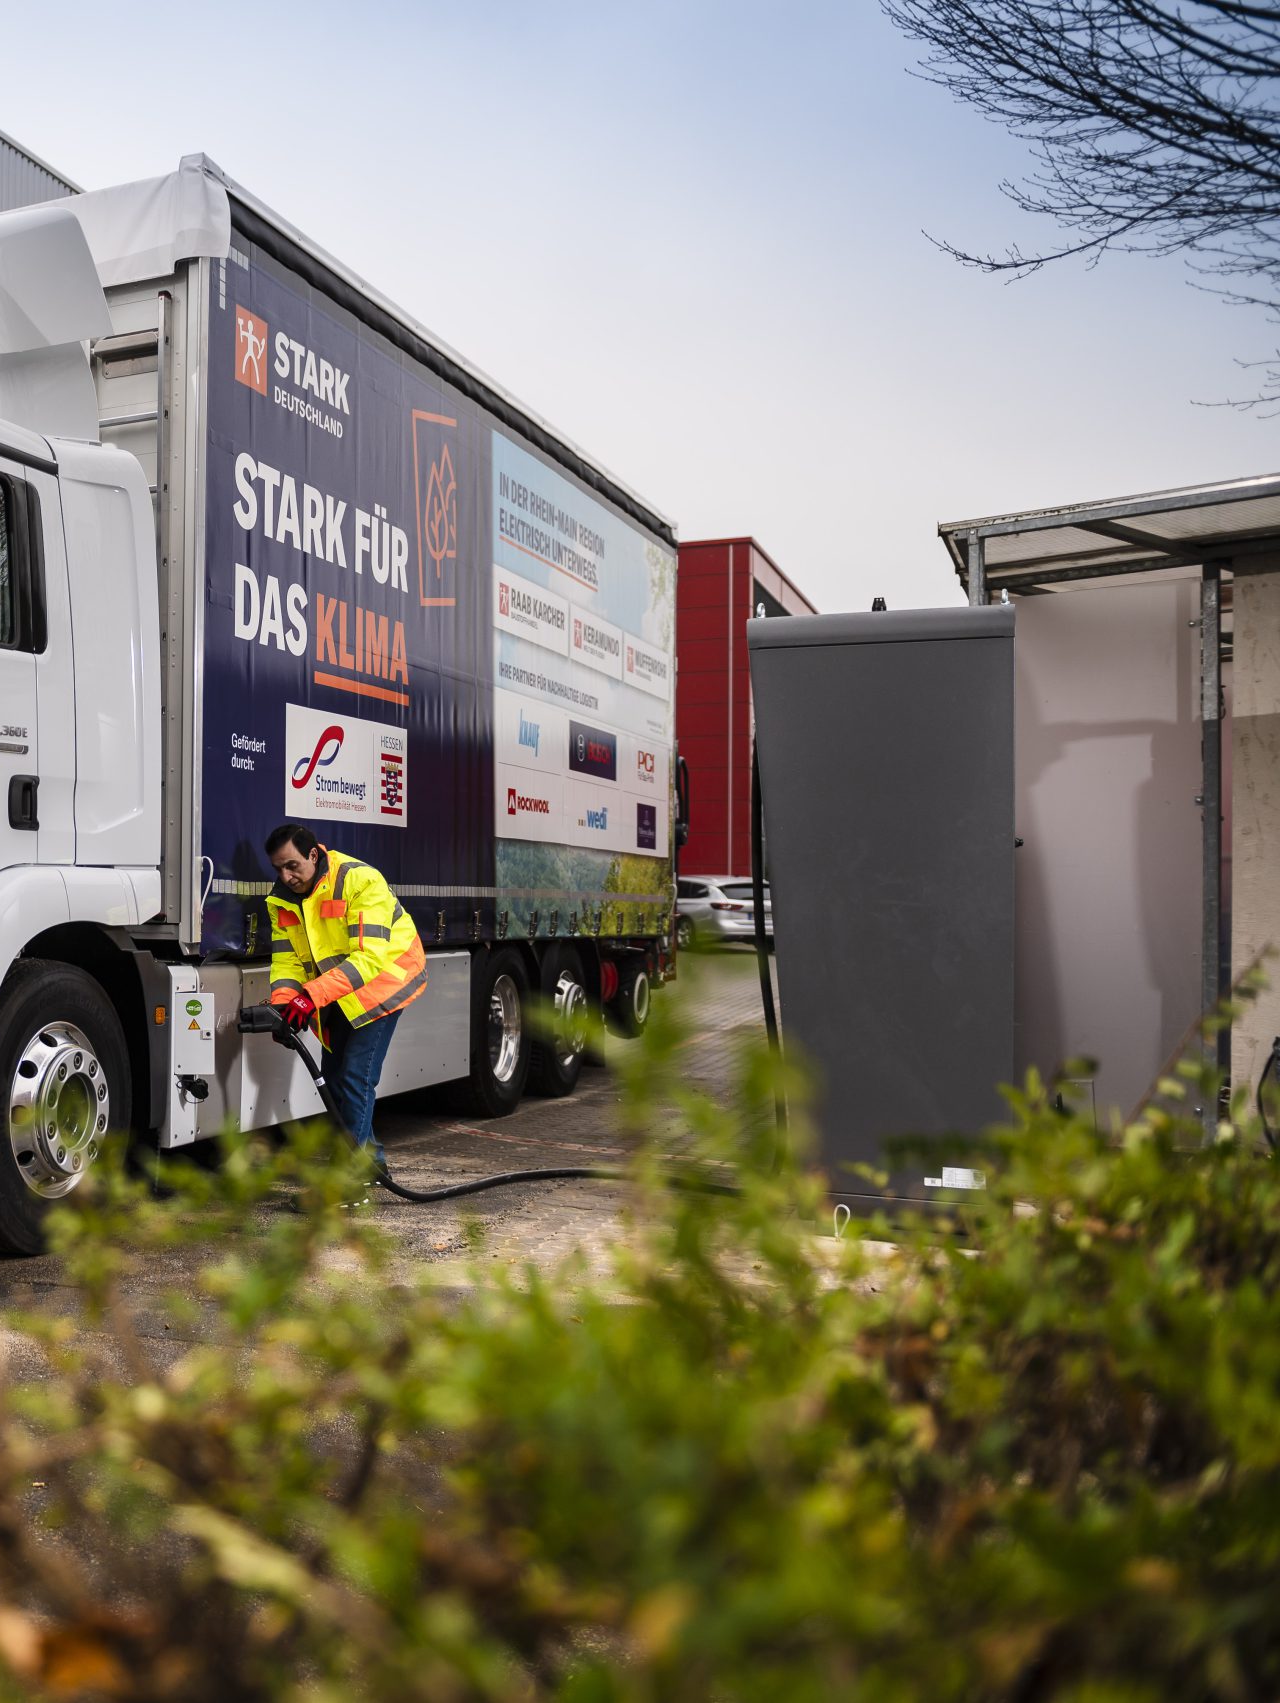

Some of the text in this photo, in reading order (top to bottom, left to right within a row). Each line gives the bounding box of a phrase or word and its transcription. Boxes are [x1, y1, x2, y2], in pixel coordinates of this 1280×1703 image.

[274, 331, 350, 415] STARK
[274, 385, 343, 438] DEUTSCHLAND
[233, 452, 409, 593] STARK FÜR
[499, 472, 605, 560] IN DER RHEIN-MAIN REGION
[499, 507, 550, 558] ELEKTRISCH
[511, 588, 565, 631] RAAB KARCHER
[233, 563, 410, 686] DAS KLIMA
[583, 623, 620, 657] KERAMUNDO
[513, 667, 536, 688] PARTNER
[537, 673, 547, 691] FÜR
[231, 733, 266, 754] Gefördert
[381, 735, 403, 751] HESSEN
[231, 753, 255, 771] durch:
[637, 750, 655, 773] PCI
[315, 774, 366, 800] Strom bewegt
[315, 797, 367, 812] Elektromobilität Hessen
[517, 795, 550, 814] ROCKWOOL
[587, 808, 608, 831] wedi
